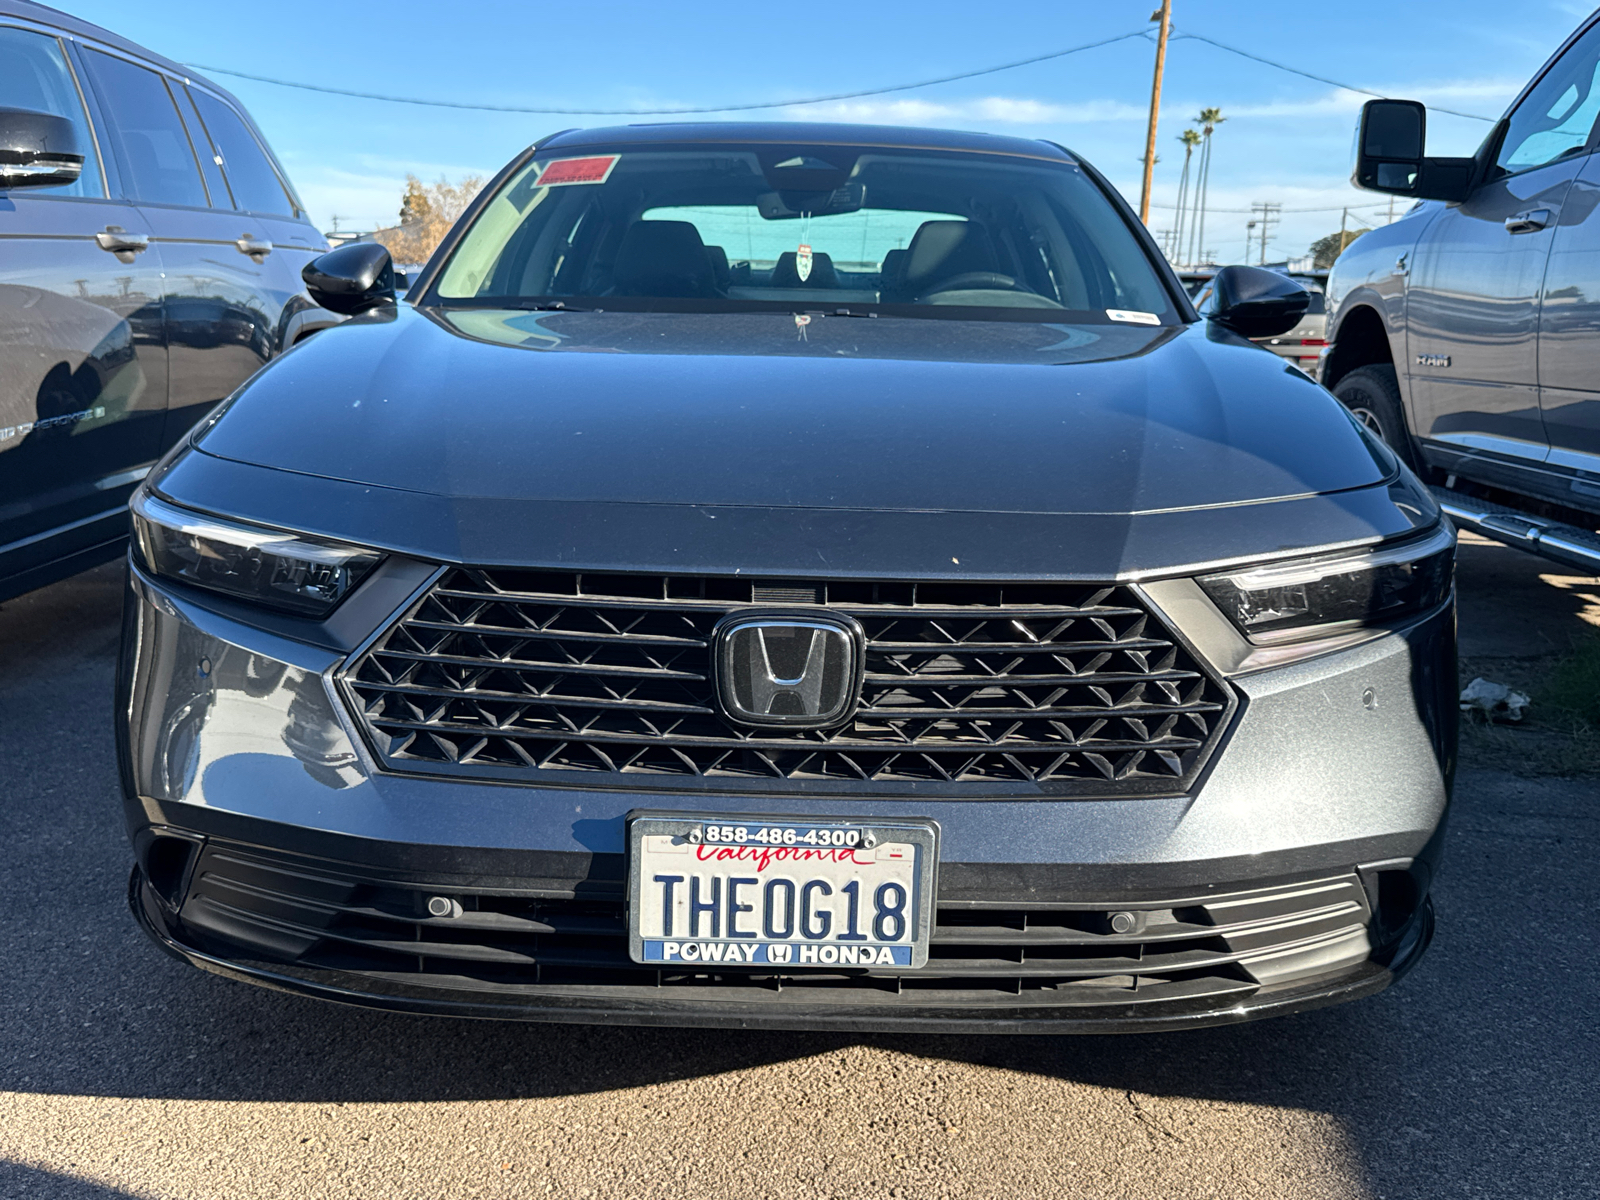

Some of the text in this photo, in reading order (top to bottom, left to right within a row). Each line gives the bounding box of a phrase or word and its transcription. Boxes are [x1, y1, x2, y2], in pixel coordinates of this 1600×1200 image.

[1416, 353, 1451, 368] RAM
[706, 826, 860, 847] 858-486-4300
[696, 844, 876, 872] California
[653, 875, 907, 942] THEOG18
[663, 942, 760, 962] POWAY
[799, 945, 896, 965] HONDA
